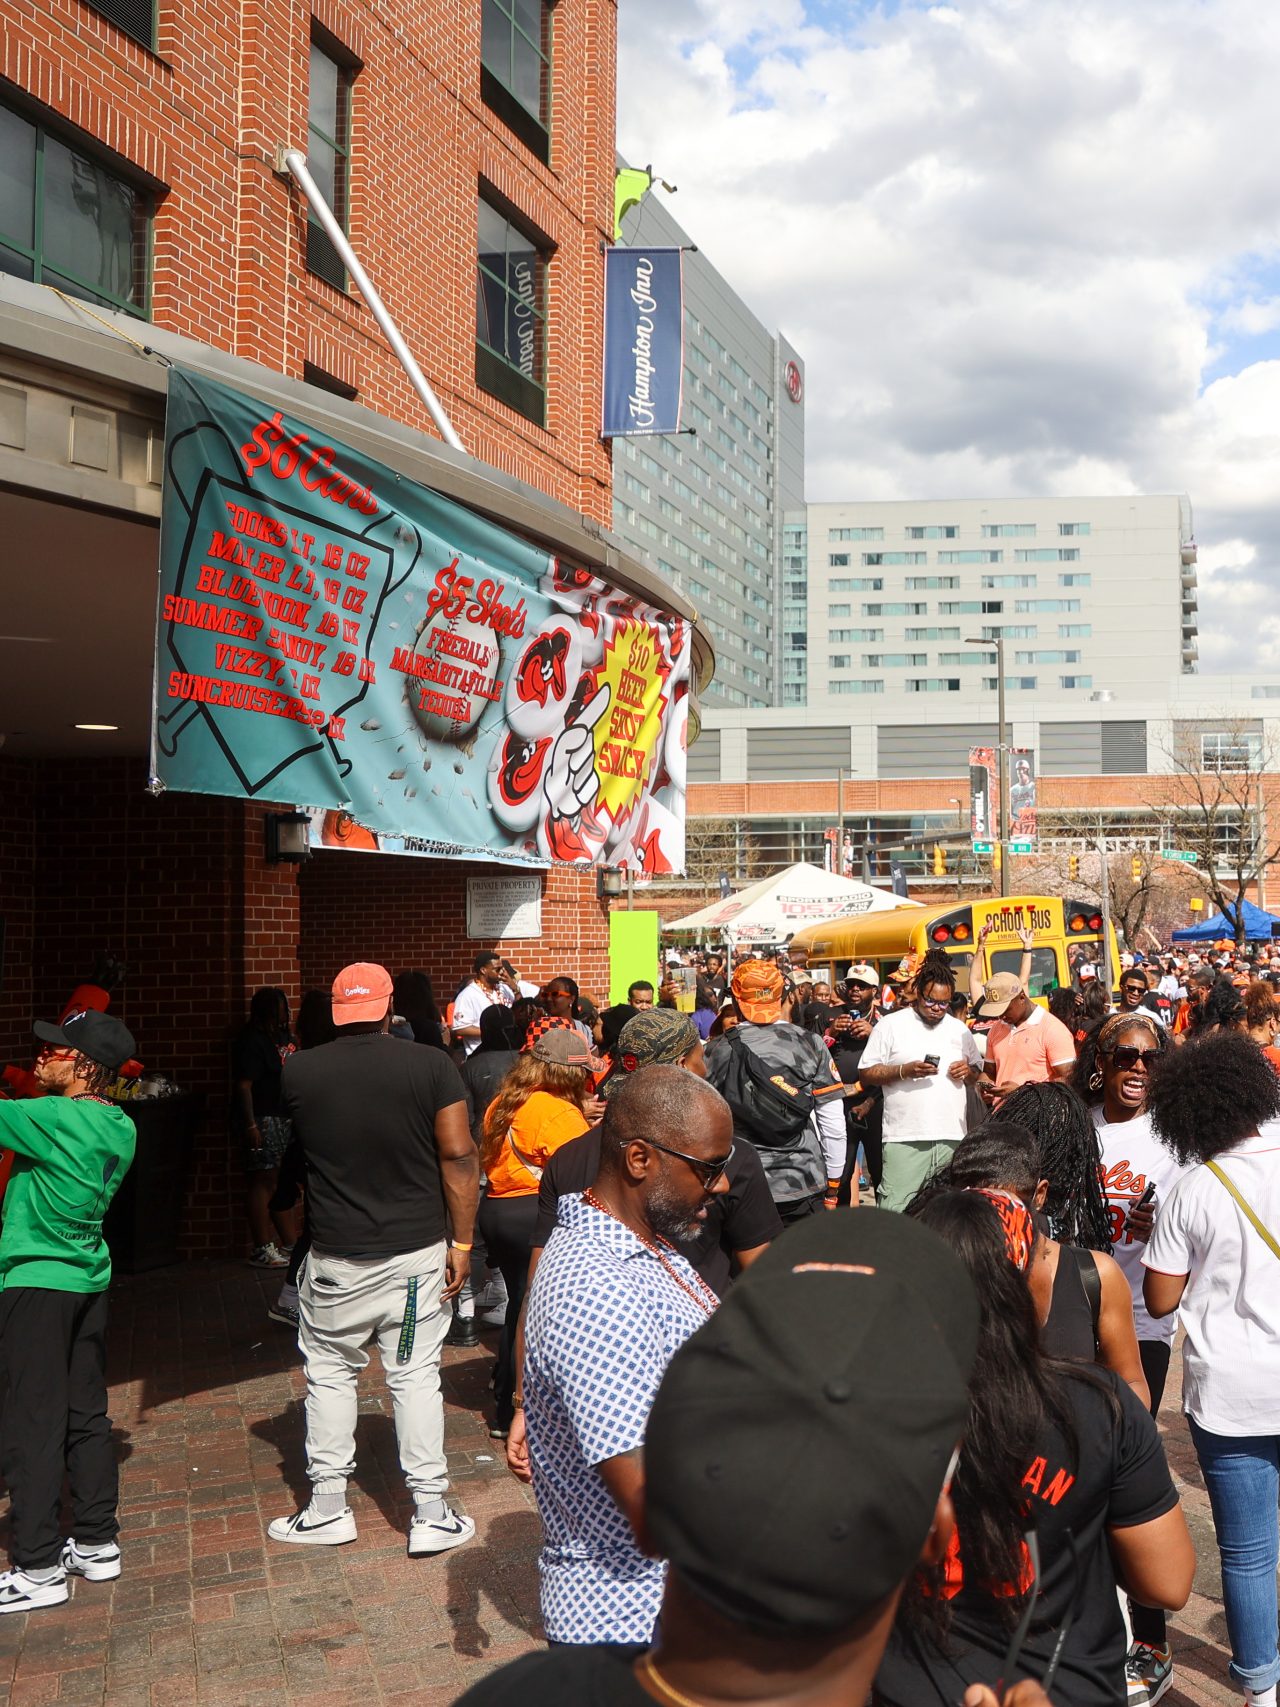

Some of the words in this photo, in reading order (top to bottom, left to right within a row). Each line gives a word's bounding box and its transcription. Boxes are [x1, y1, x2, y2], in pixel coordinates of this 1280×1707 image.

[630, 257, 656, 313] Inn
[629, 316, 654, 427] Hampton
[240, 412, 309, 479] $6
[300, 446, 379, 515] Cans
[322, 543, 343, 571] 16
[345, 551, 371, 580] OZ
[341, 586, 368, 614] OZ
[426, 557, 475, 619] $5
[466, 578, 528, 640] Shots
[162, 594, 264, 642] SUMMER
[331, 650, 356, 677] 16
[358, 656, 377, 685] OZ
[316, 611, 339, 639] 16
[343, 618, 361, 646] OZ
[426, 627, 490, 668] FIREBALL
[214, 643, 285, 687] VIZZY,
[301, 674, 321, 701] OZ
[628, 633, 650, 673] $10
[389, 647, 504, 702] MARGARITAVILLE
[616, 668, 647, 709] BEER
[418, 688, 472, 723] TEQUILA
[610, 706, 646, 744] SHOT
[328, 714, 346, 741] OZ
[472, 881, 499, 890] PRIVATE
[500, 880, 537, 889] PROPERTY
[986, 911, 1027, 933] SCHOOL
[1030, 909, 1051, 929] BUS
[345, 985, 371, 996] Cookies
